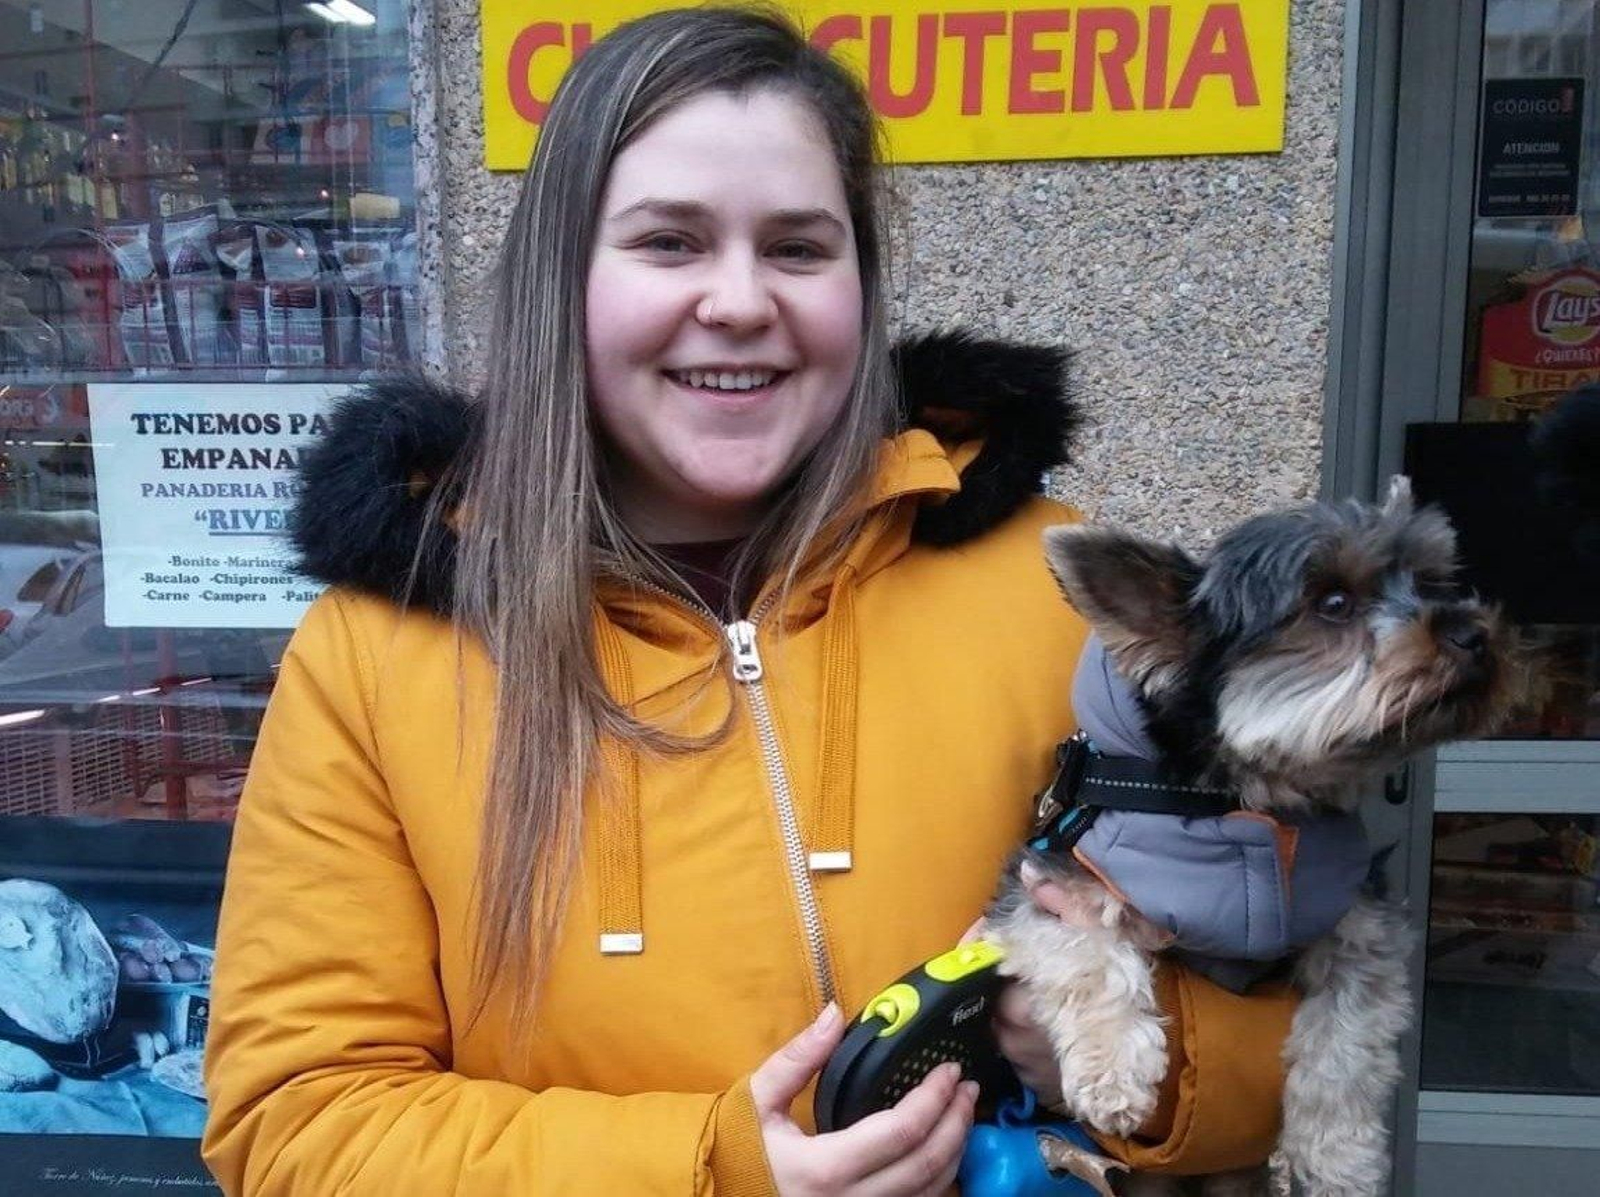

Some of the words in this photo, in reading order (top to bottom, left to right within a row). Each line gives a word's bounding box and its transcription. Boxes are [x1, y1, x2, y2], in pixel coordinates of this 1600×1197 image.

[507, 3, 1261, 126] CUTERIA
[131, 413, 281, 435] TENEMOS
[288, 413, 333, 435] PA
[161, 448, 302, 470] EMPANA
[141, 482, 267, 498] PANADERIA
[140, 572, 200, 584] -Bacalao
[142, 589, 190, 601] -Carne
[198, 589, 267, 603] -Campera
